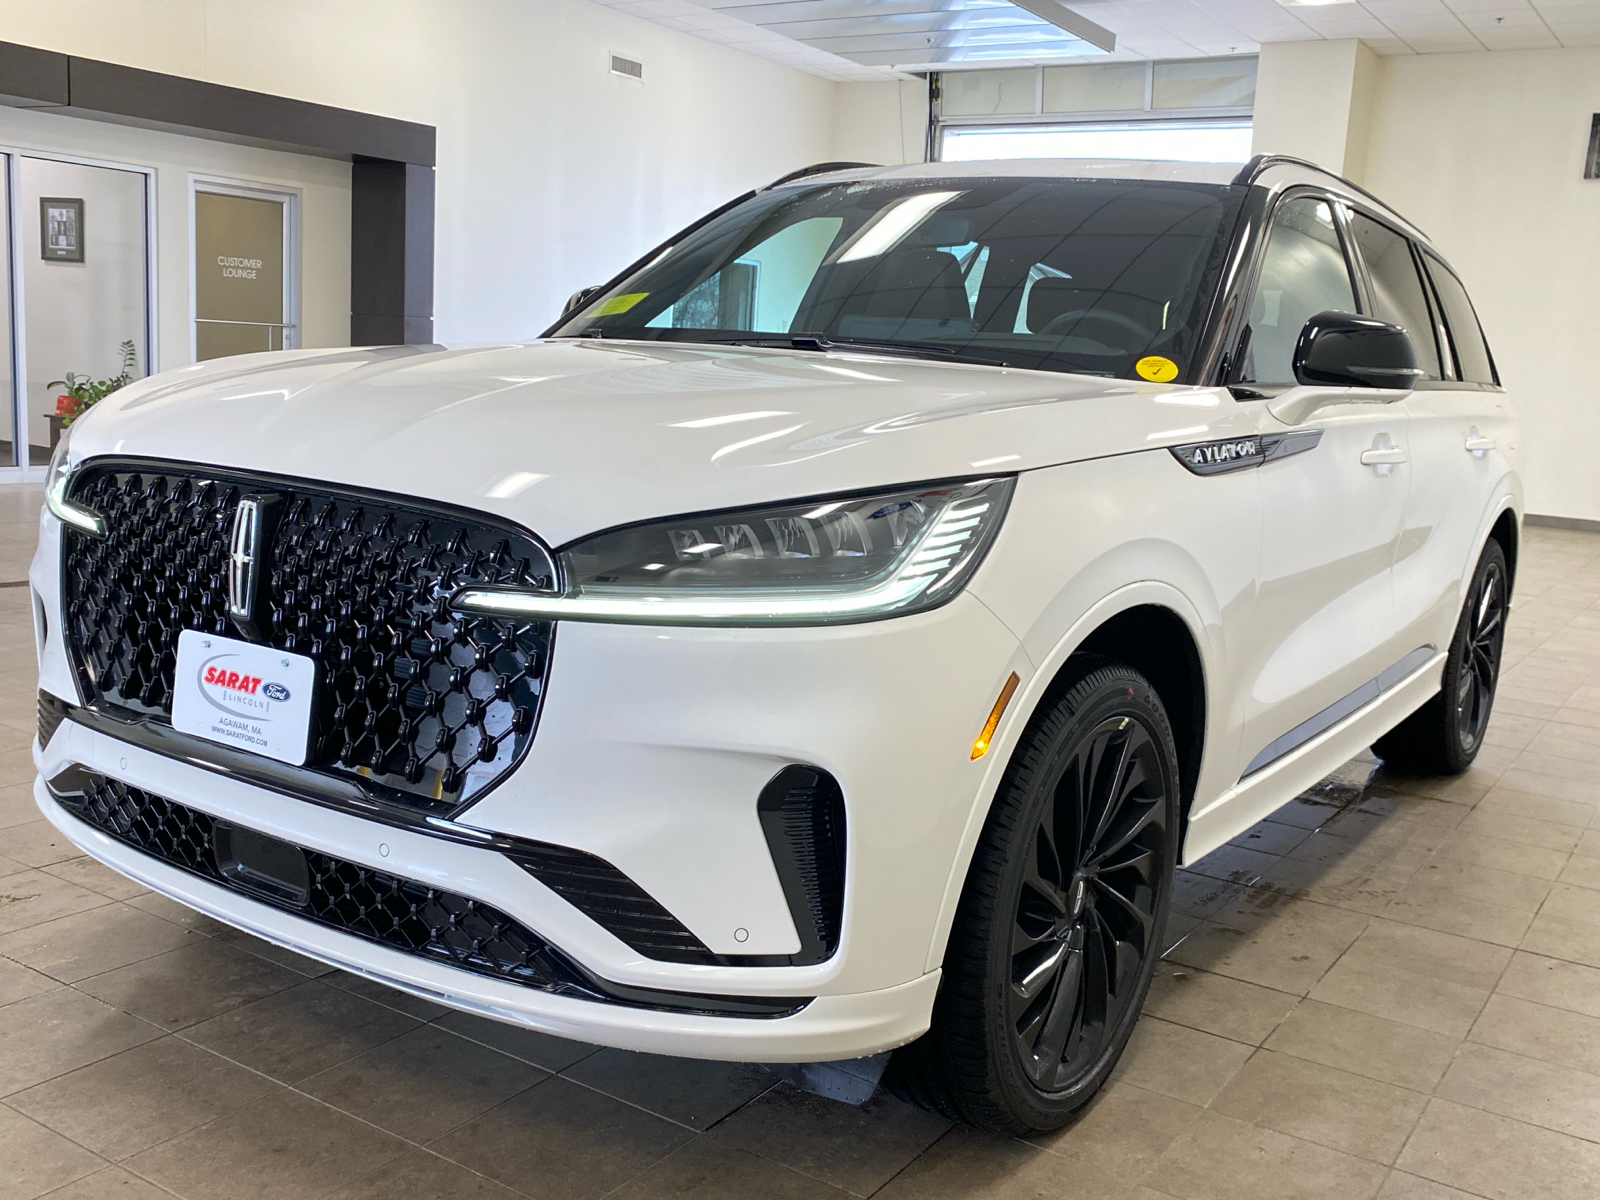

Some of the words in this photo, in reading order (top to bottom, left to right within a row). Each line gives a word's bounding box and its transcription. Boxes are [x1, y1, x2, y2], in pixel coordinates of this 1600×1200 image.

[217, 256, 263, 269] CUSTOMER
[223, 268, 257, 280] LOUNGE
[1194, 441, 1256, 464] AVIATOR
[203, 665, 262, 695] SARAT
[266, 684, 286, 701] Ford
[229, 695, 264, 709] LINCOLN
[219, 717, 250, 733] AGAWAM,
[252, 726, 262, 736] MA
[211, 725, 268, 747] WWW.SARATFORD.COM
